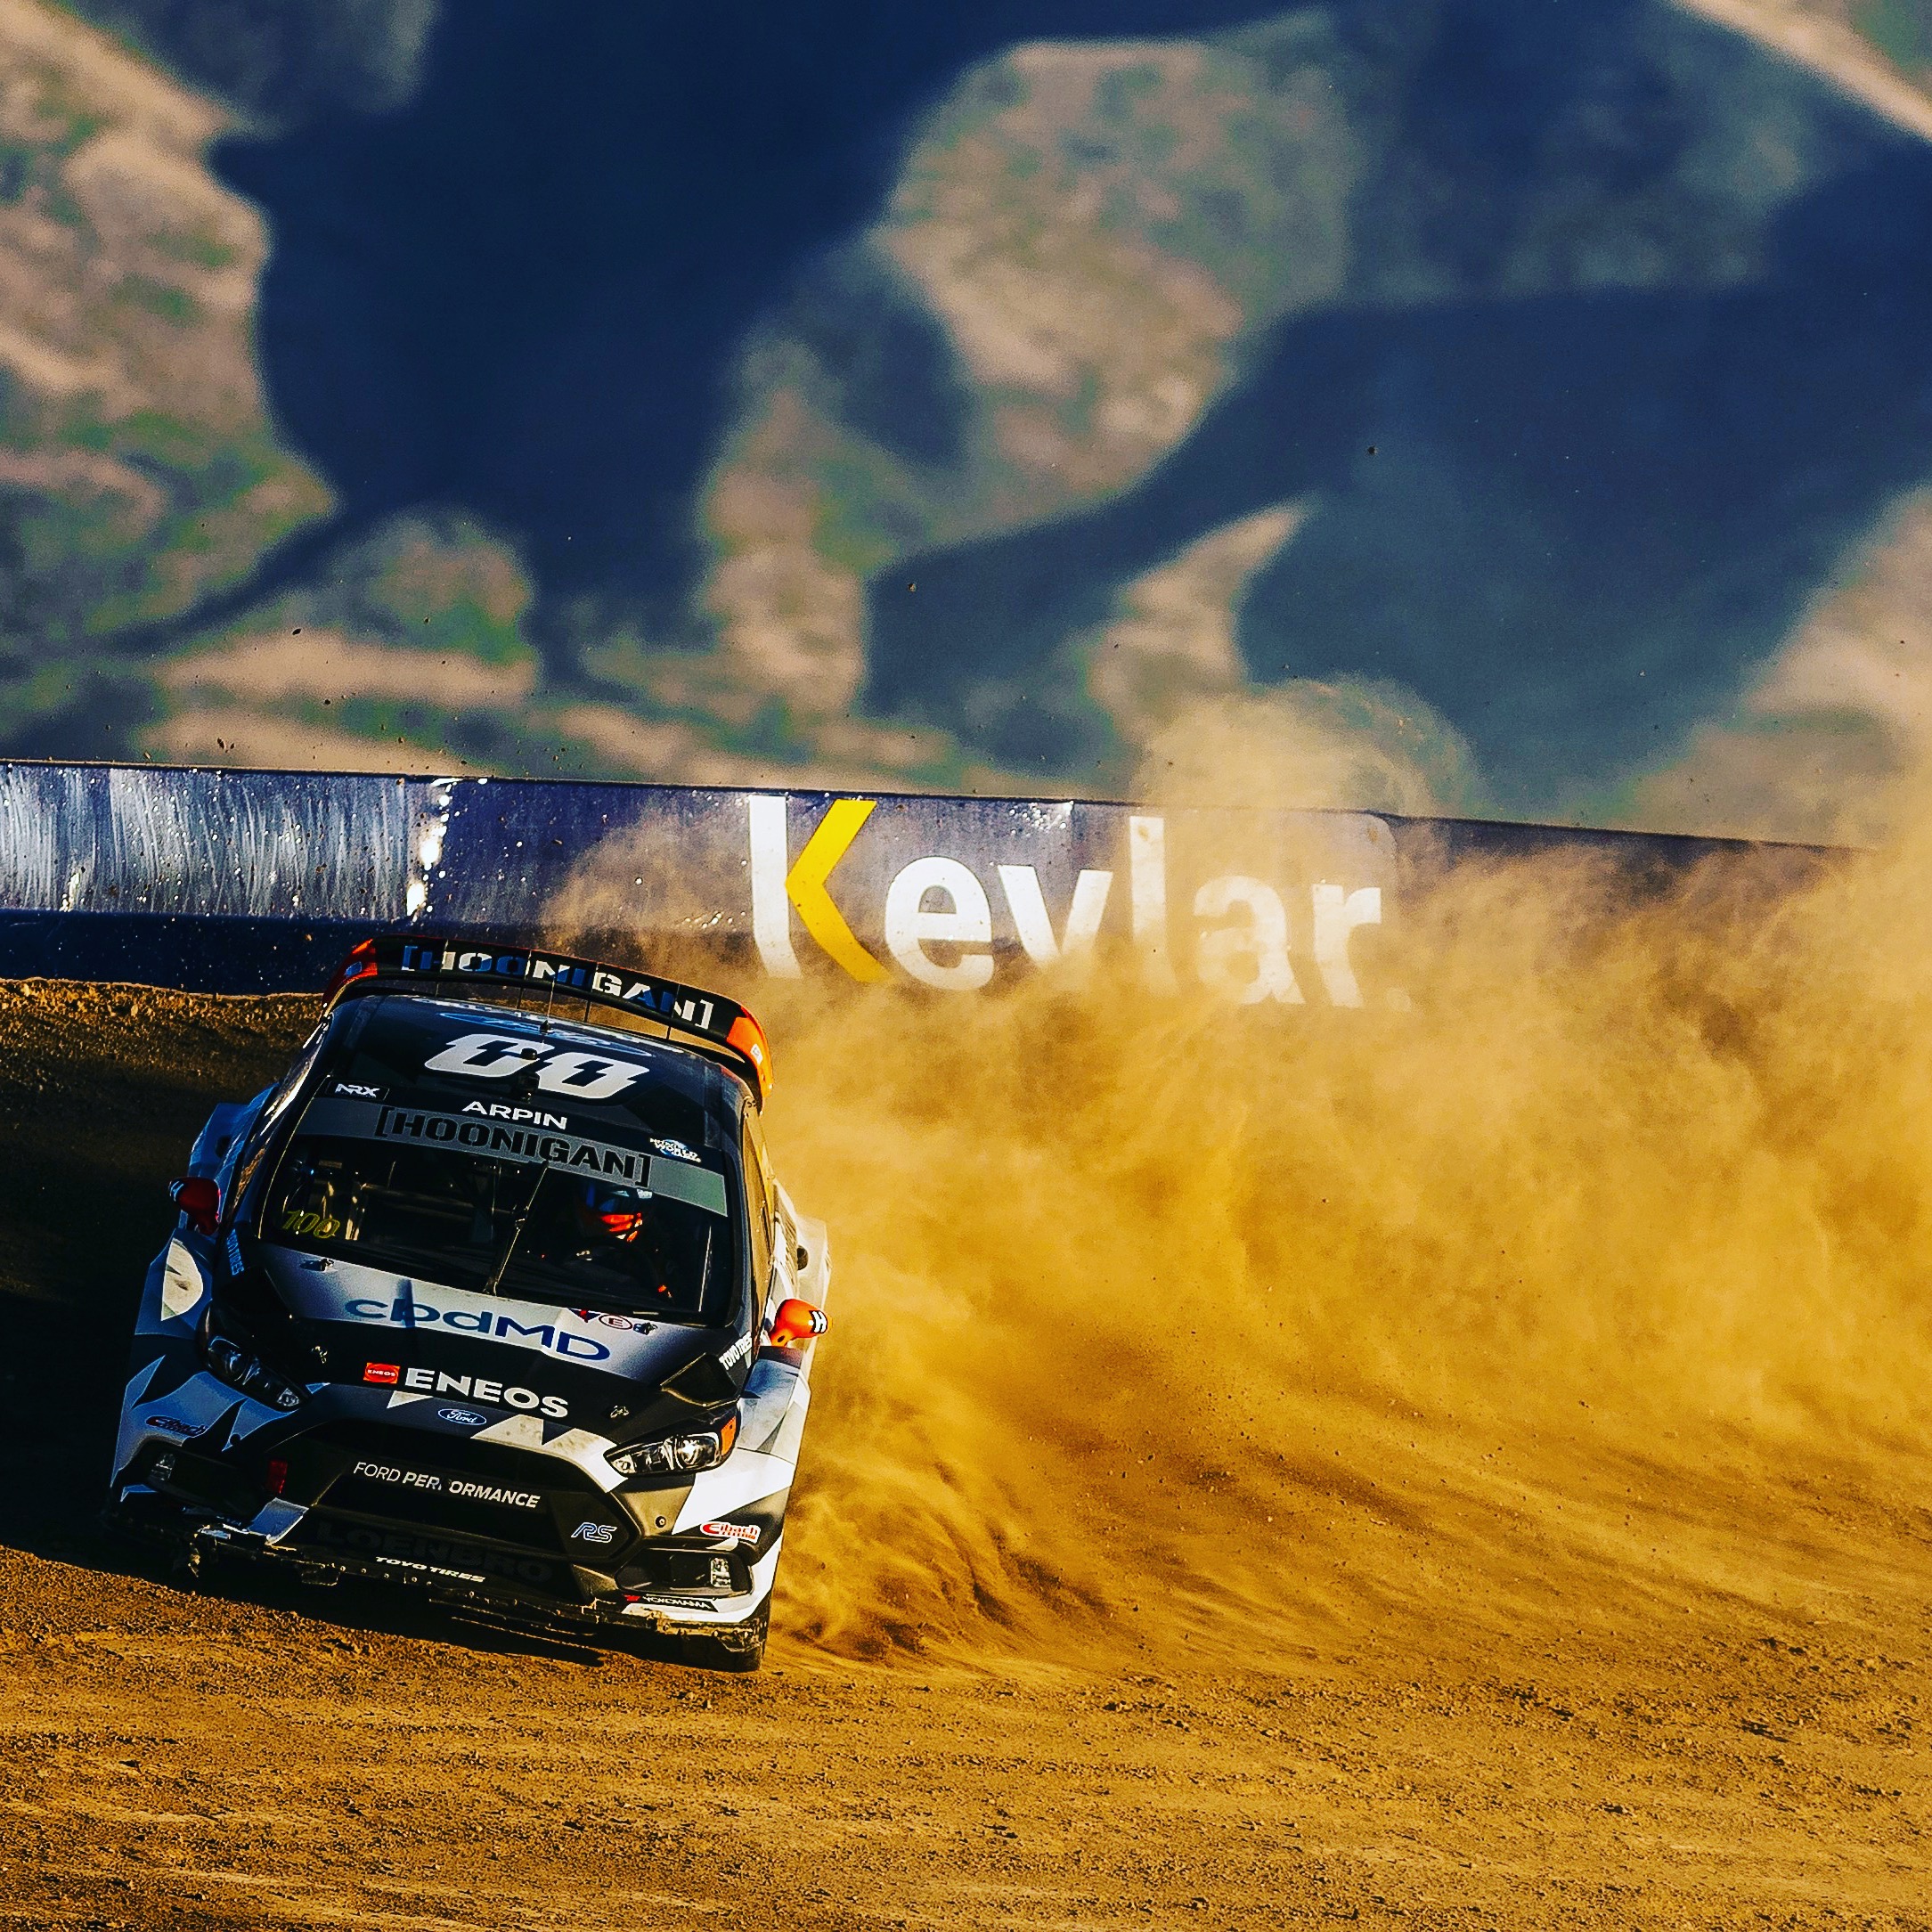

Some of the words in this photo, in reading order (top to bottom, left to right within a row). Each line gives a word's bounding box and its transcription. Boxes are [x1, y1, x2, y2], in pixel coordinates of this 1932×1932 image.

[335, 1083, 380, 1097] NRX
[461, 1101, 568, 1129] ARPIN
[344, 1298, 611, 1361] cbdMD
[718, 1344, 741, 1371] TOYO
[366, 1368, 396, 1377] ENEOS
[404, 1367, 568, 1418] ENEOS
[446, 1410, 478, 1423] Ford
[353, 1462, 402, 1482] FORD
[402, 1471, 542, 1509] PERORMANCE
[570, 1521, 618, 1544] RS
[375, 1556, 428, 1570] TOYO
[429, 1566, 486, 1583] TIRES
